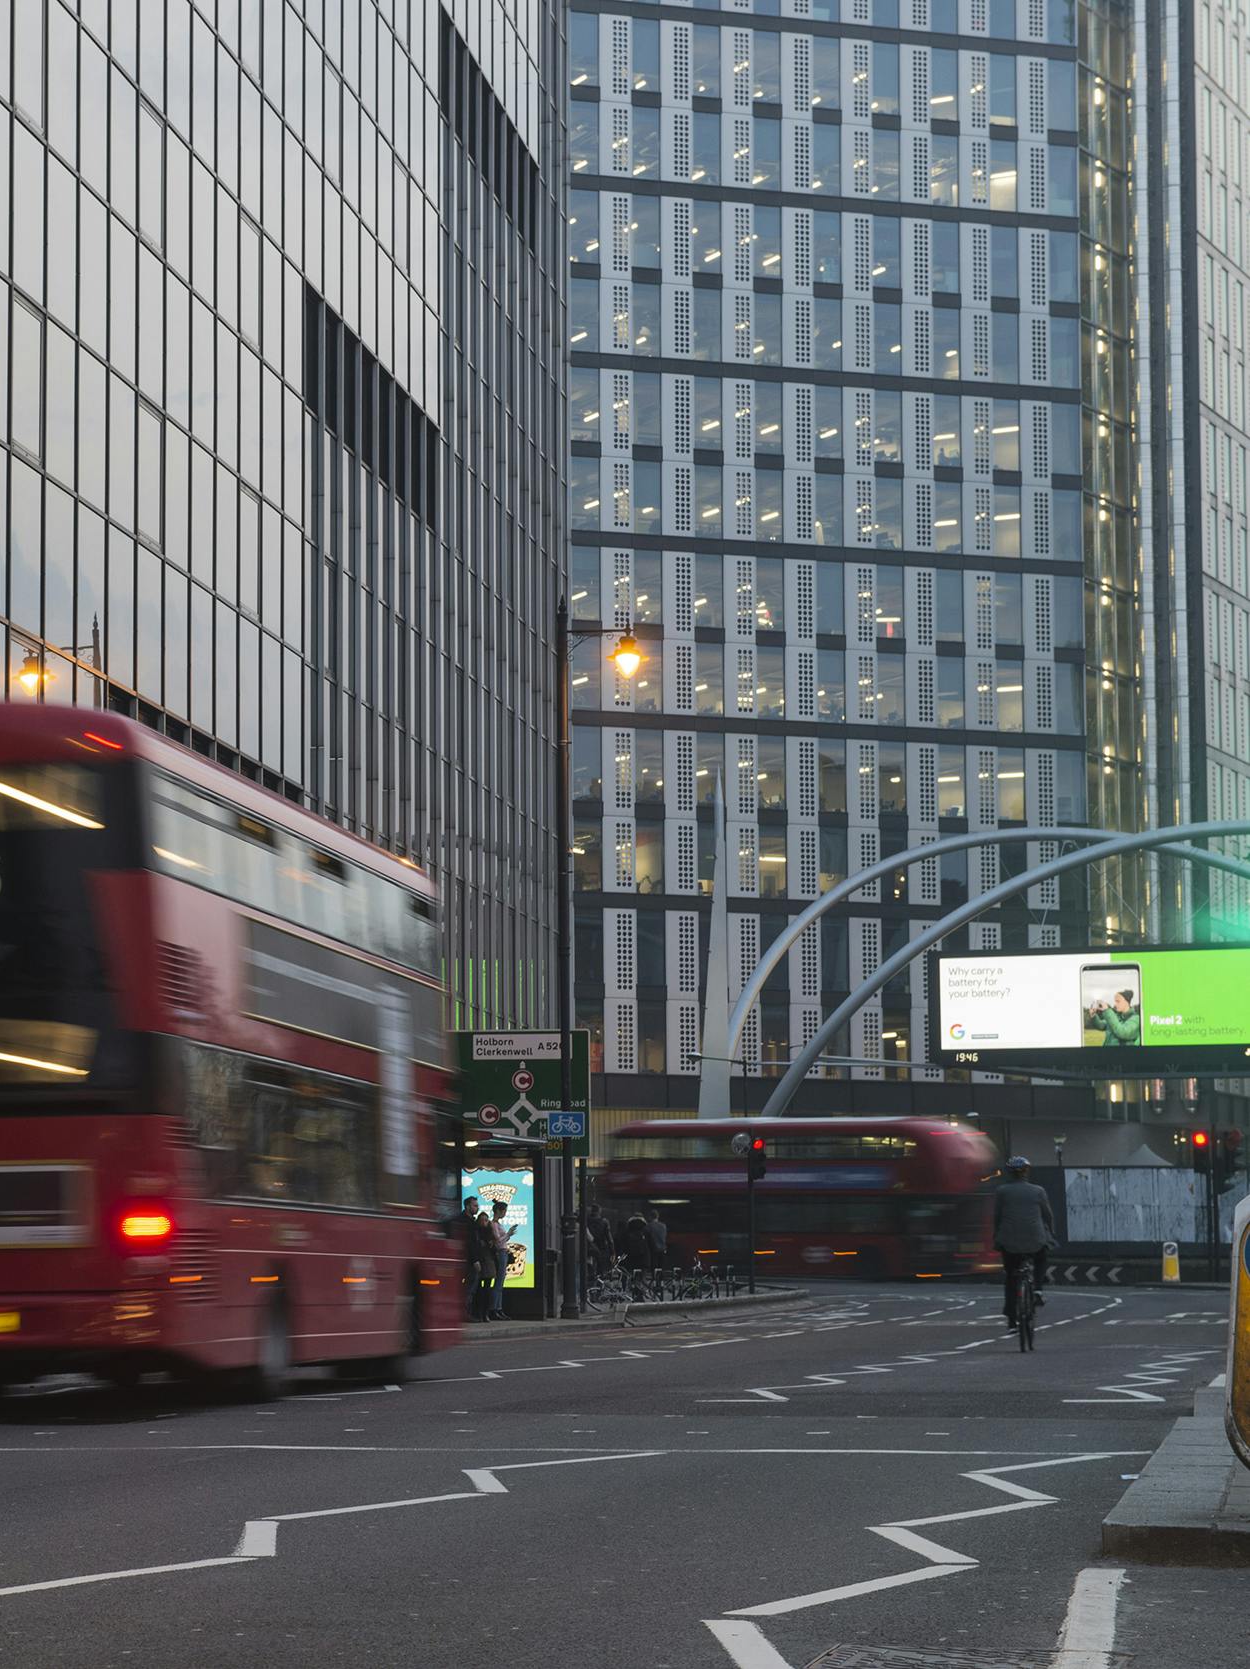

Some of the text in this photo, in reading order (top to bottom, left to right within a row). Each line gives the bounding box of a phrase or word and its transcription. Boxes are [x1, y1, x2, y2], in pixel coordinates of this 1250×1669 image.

[948, 967, 1004, 978] Why carry a
[948, 976, 999, 988] battery for
[948, 987, 1011, 1000] your battery?
[1150, 1015, 1205, 1025] Pixel 2 with
[476, 1037, 514, 1046] Holborn
[538, 1042, 562, 1051] A52
[476, 1047, 533, 1056] Clerkenwell
[541, 1099, 586, 1109] Ring oad
